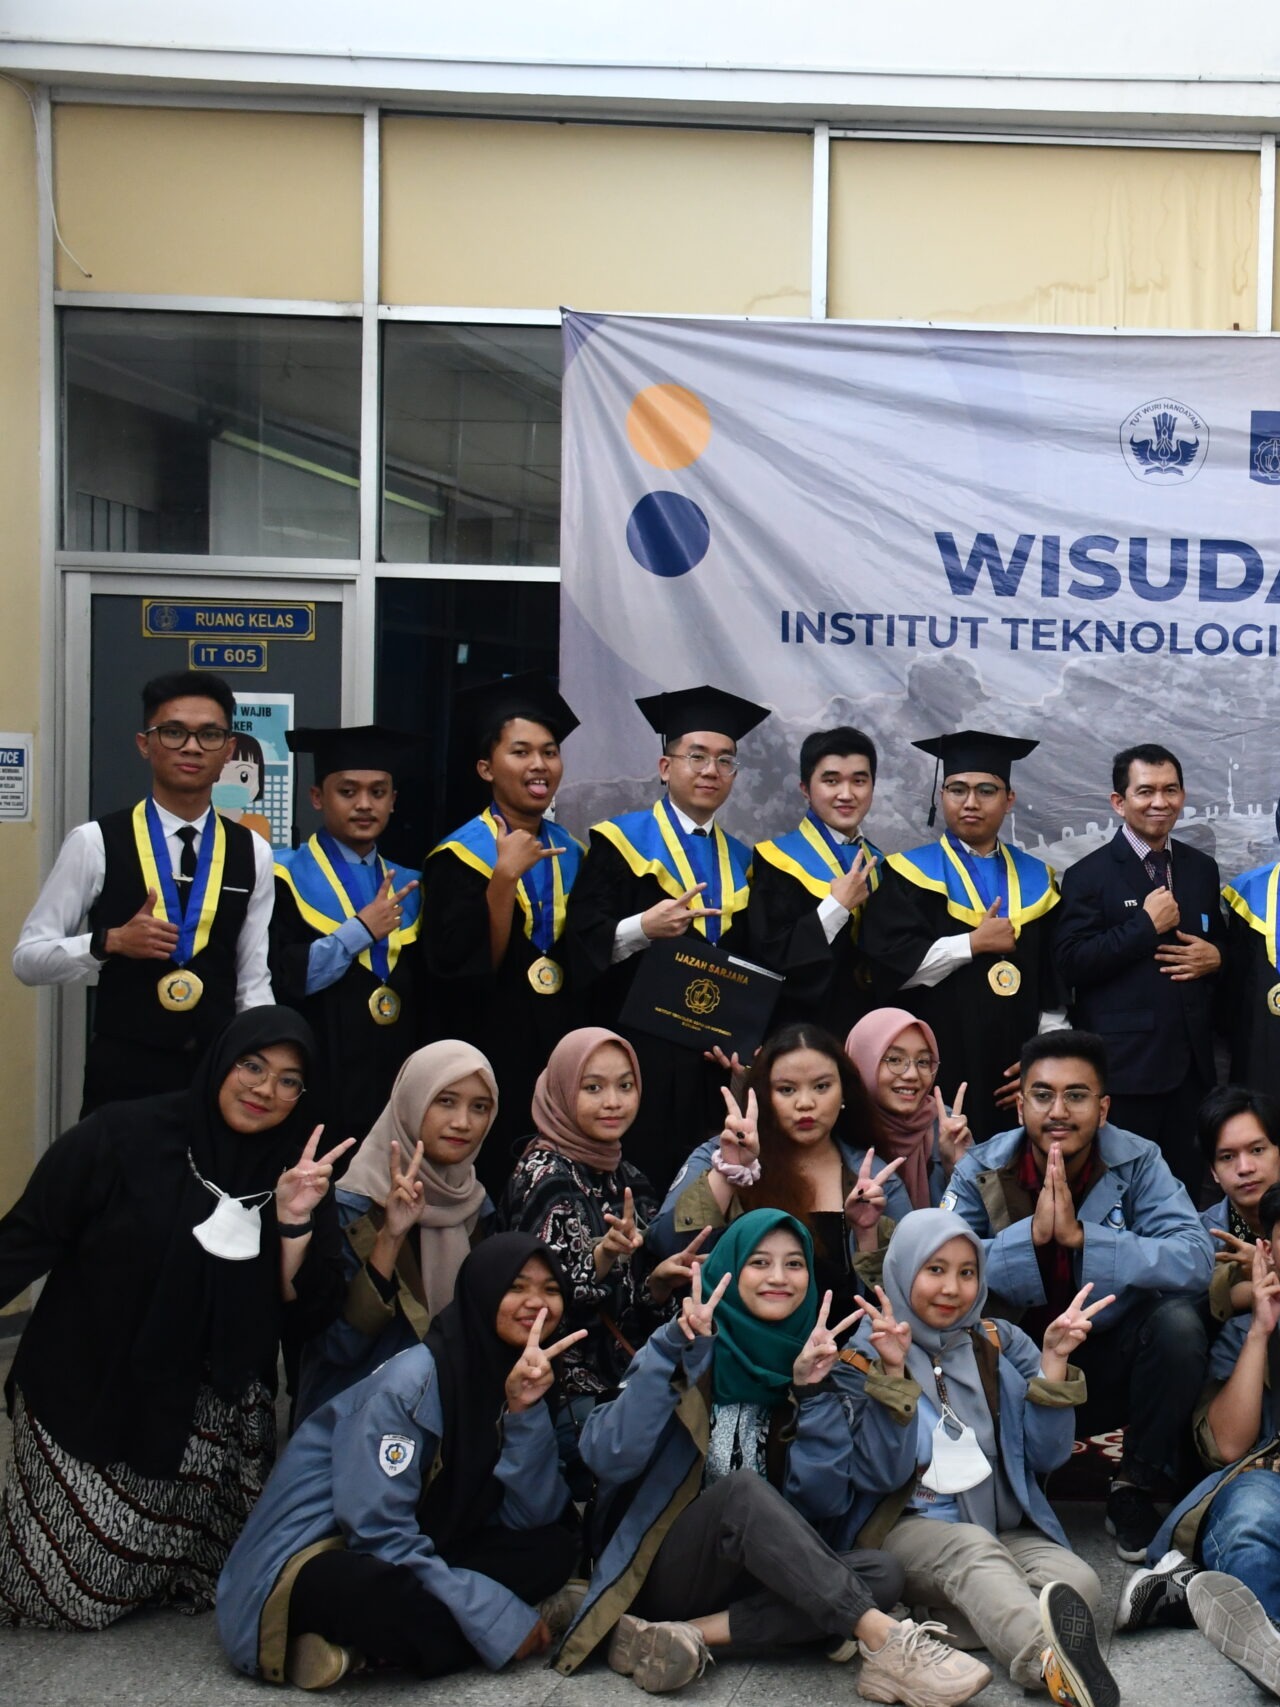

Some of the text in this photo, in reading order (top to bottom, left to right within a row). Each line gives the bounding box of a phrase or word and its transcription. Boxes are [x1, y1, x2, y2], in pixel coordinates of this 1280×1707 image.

[1129, 403, 1201, 430] TUT WURI HANDAYANI
[195, 612, 294, 628] RUANG KELAS
[780, 610, 989, 649] INSTITUT
[1001, 617, 1277, 657] TEKNOLOGI
[201, 648, 257, 663] IT 605
[240, 706, 272, 717] WAJIB
[675, 952, 708, 970] IJAZAH
[708, 963, 750, 985] SARJANA
